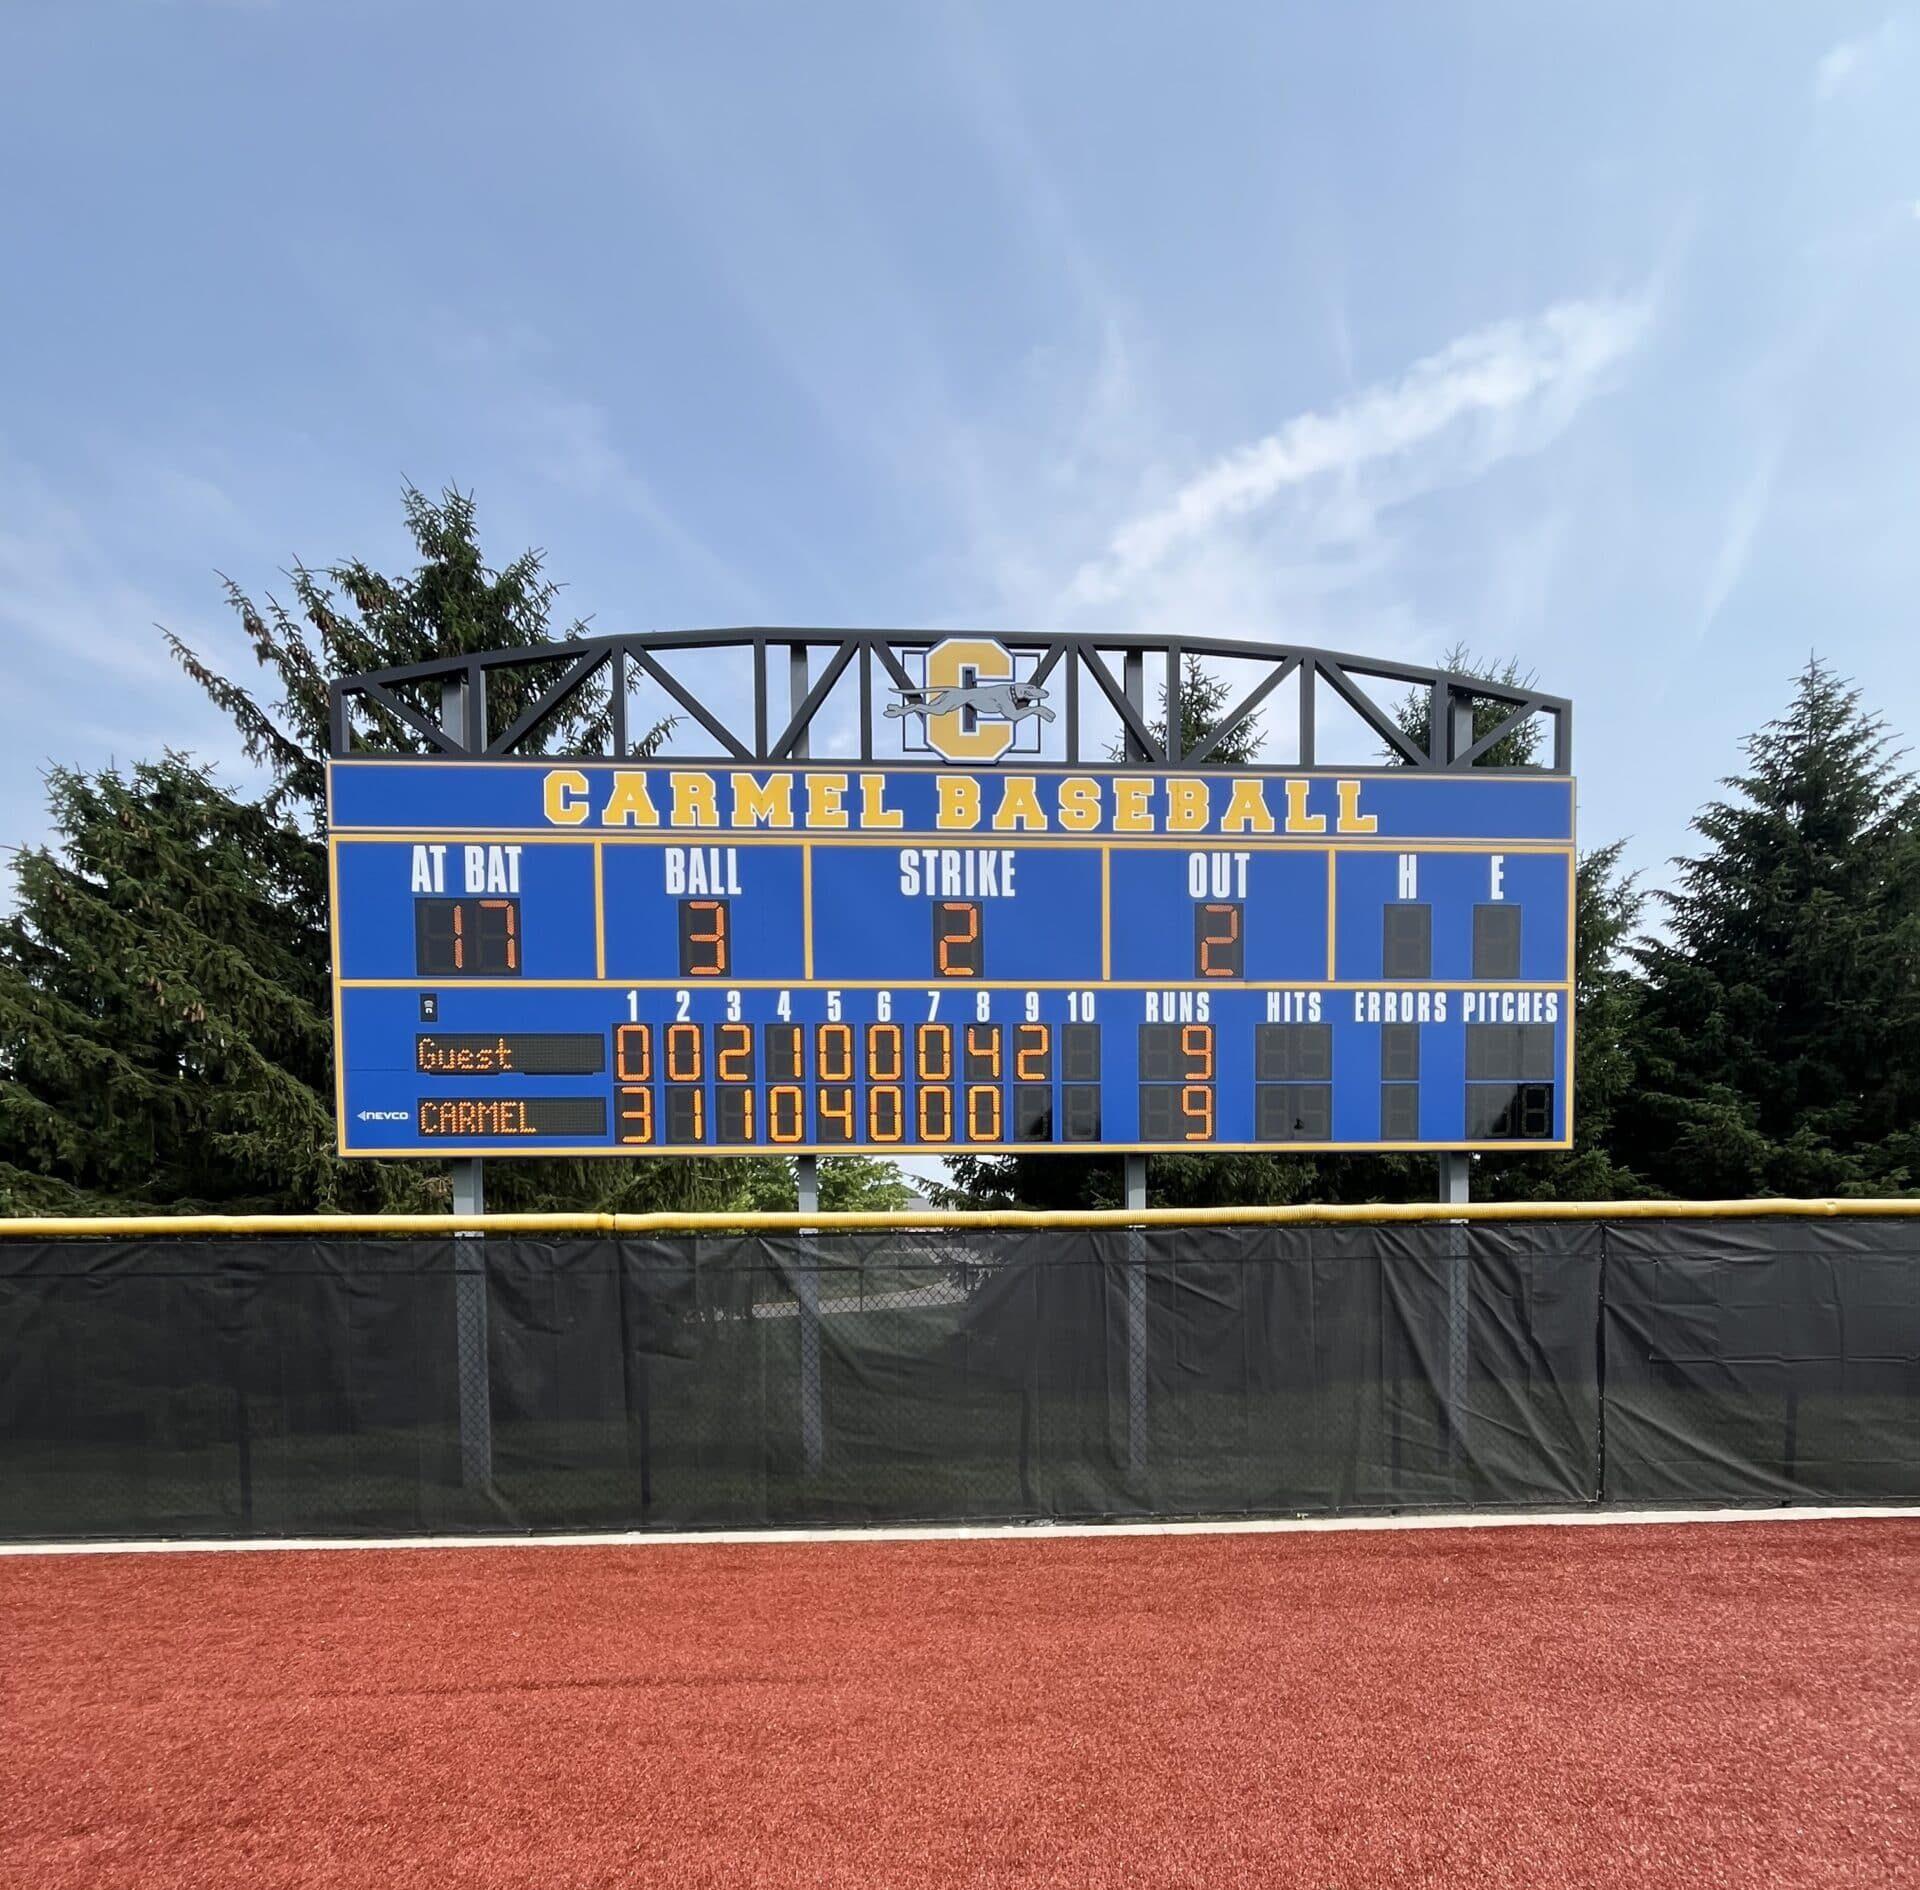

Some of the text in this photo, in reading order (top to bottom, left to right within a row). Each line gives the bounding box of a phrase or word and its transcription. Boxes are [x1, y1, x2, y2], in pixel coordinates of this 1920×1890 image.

[923, 636, 1016, 765] C
[543, 769, 1379, 833] CARMEL BASEBALL
[411, 845, 522, 893] AT BAT
[665, 848, 742, 894] BALL
[900, 849, 1016, 897] STRIKE
[1188, 852, 1250, 898] OUT
[1399, 854, 1417, 900] H
[1490, 855, 1505, 900] E
[453, 900, 515, 969] 17
[688, 901, 725, 975] 3
[939, 903, 977, 976] 2
[1200, 904, 1238, 976] 2
[626, 990, 1096, 1022] 1 2 3 4 5 6 7 8 9 10
[1145, 992, 1210, 1023] RUNS
[1266, 992, 1322, 1023] HITS
[1354, 992, 1447, 1023] ERRORS
[1463, 992, 1558, 1023] PITCHES
[418, 1037, 512, 1070] Guest
[617, 1025, 650, 1081] 0
[668, 1025, 700, 1081] 0
[719, 1025, 751, 1081] 2
[819, 1025, 851, 1081] 0
[869, 1025, 901, 1081] 0
[919, 1025, 950, 1081] 0
[968, 1028, 999, 1078] 4
[1017, 1025, 1048, 1080] 2
[1182, 1025, 1213, 1080] 9
[366, 1111, 409, 1120] NEVCO
[421, 1101, 537, 1133] CARMEL
[622, 1087, 651, 1143] 3
[770, 1086, 802, 1142] 0
[820, 1088, 852, 1139] 4
[869, 1086, 901, 1142] 0
[919, 1086, 951, 1142] 0
[969, 1086, 1000, 1142] 0
[1182, 1085, 1212, 1140] 9
